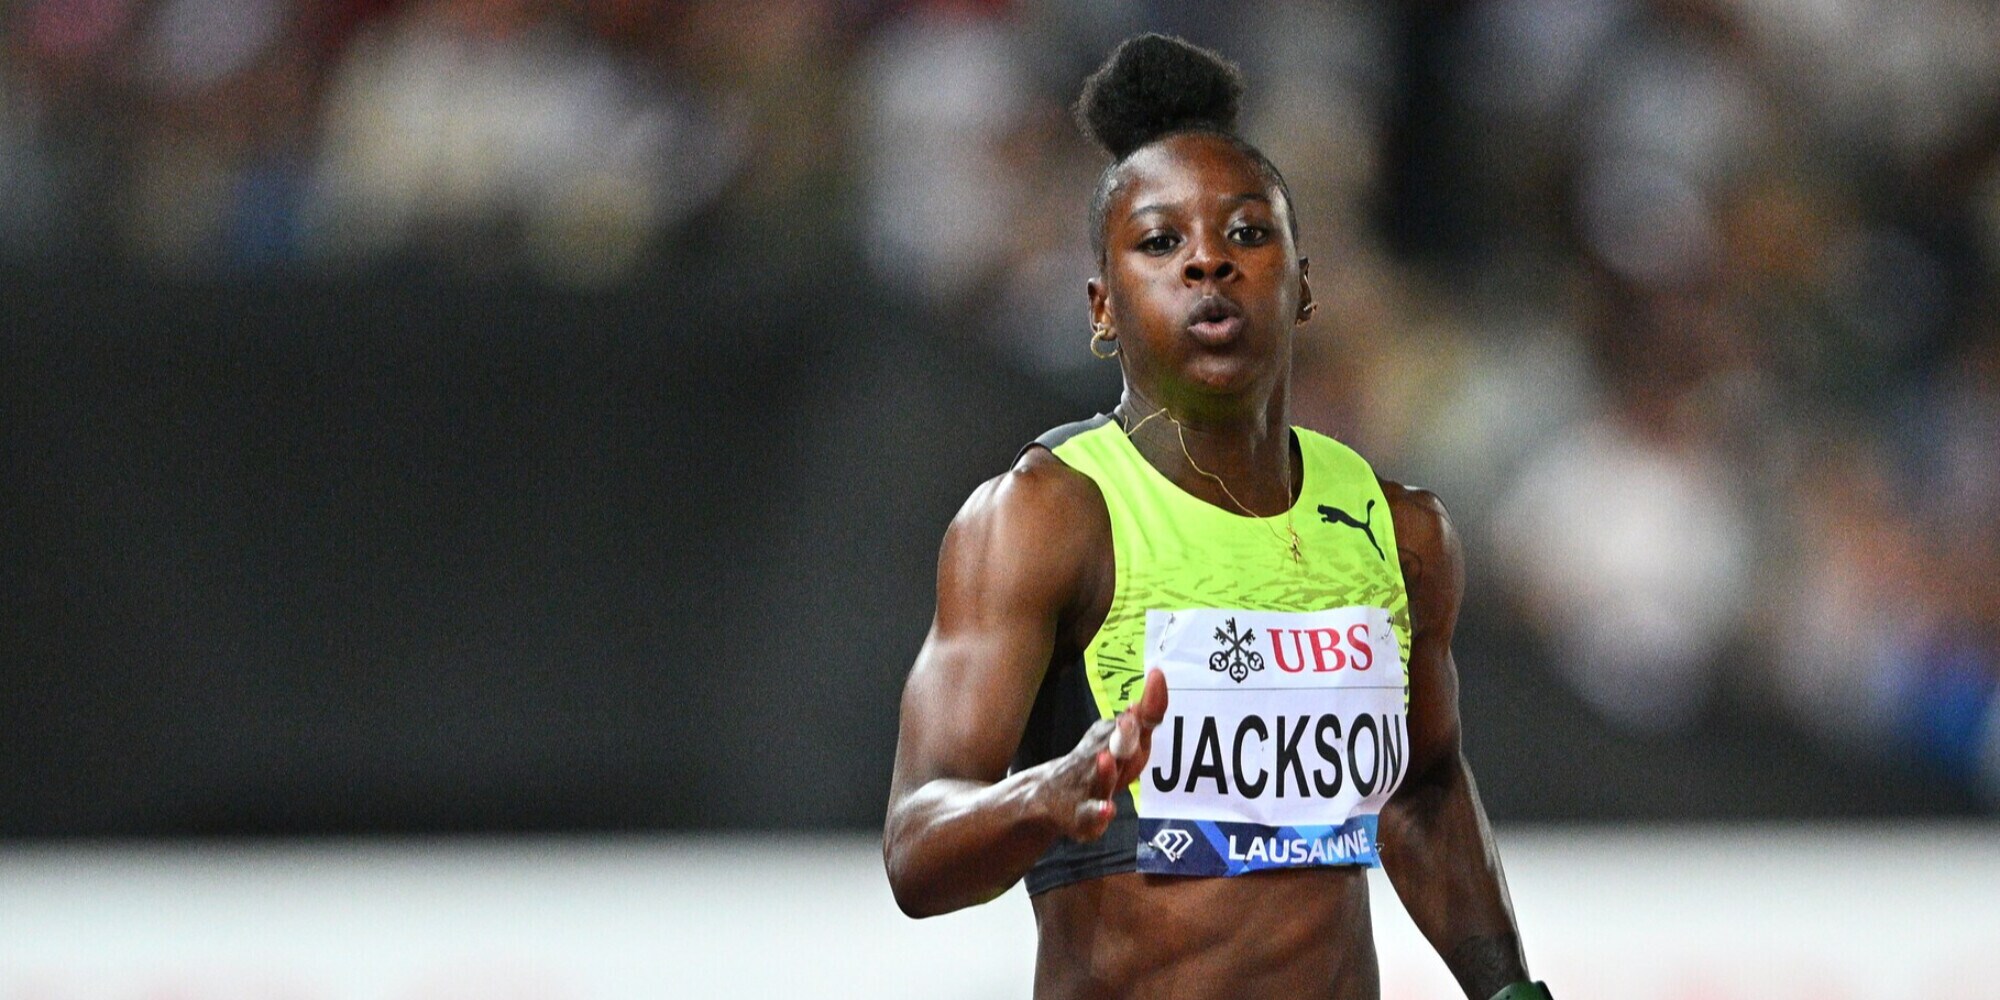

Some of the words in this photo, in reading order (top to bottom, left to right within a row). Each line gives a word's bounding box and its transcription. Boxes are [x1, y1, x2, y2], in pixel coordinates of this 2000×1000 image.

[1266, 624, 1373, 673] UBS
[1152, 713, 1402, 799] JACKSON
[1228, 828, 1370, 863] LAUSANNE
